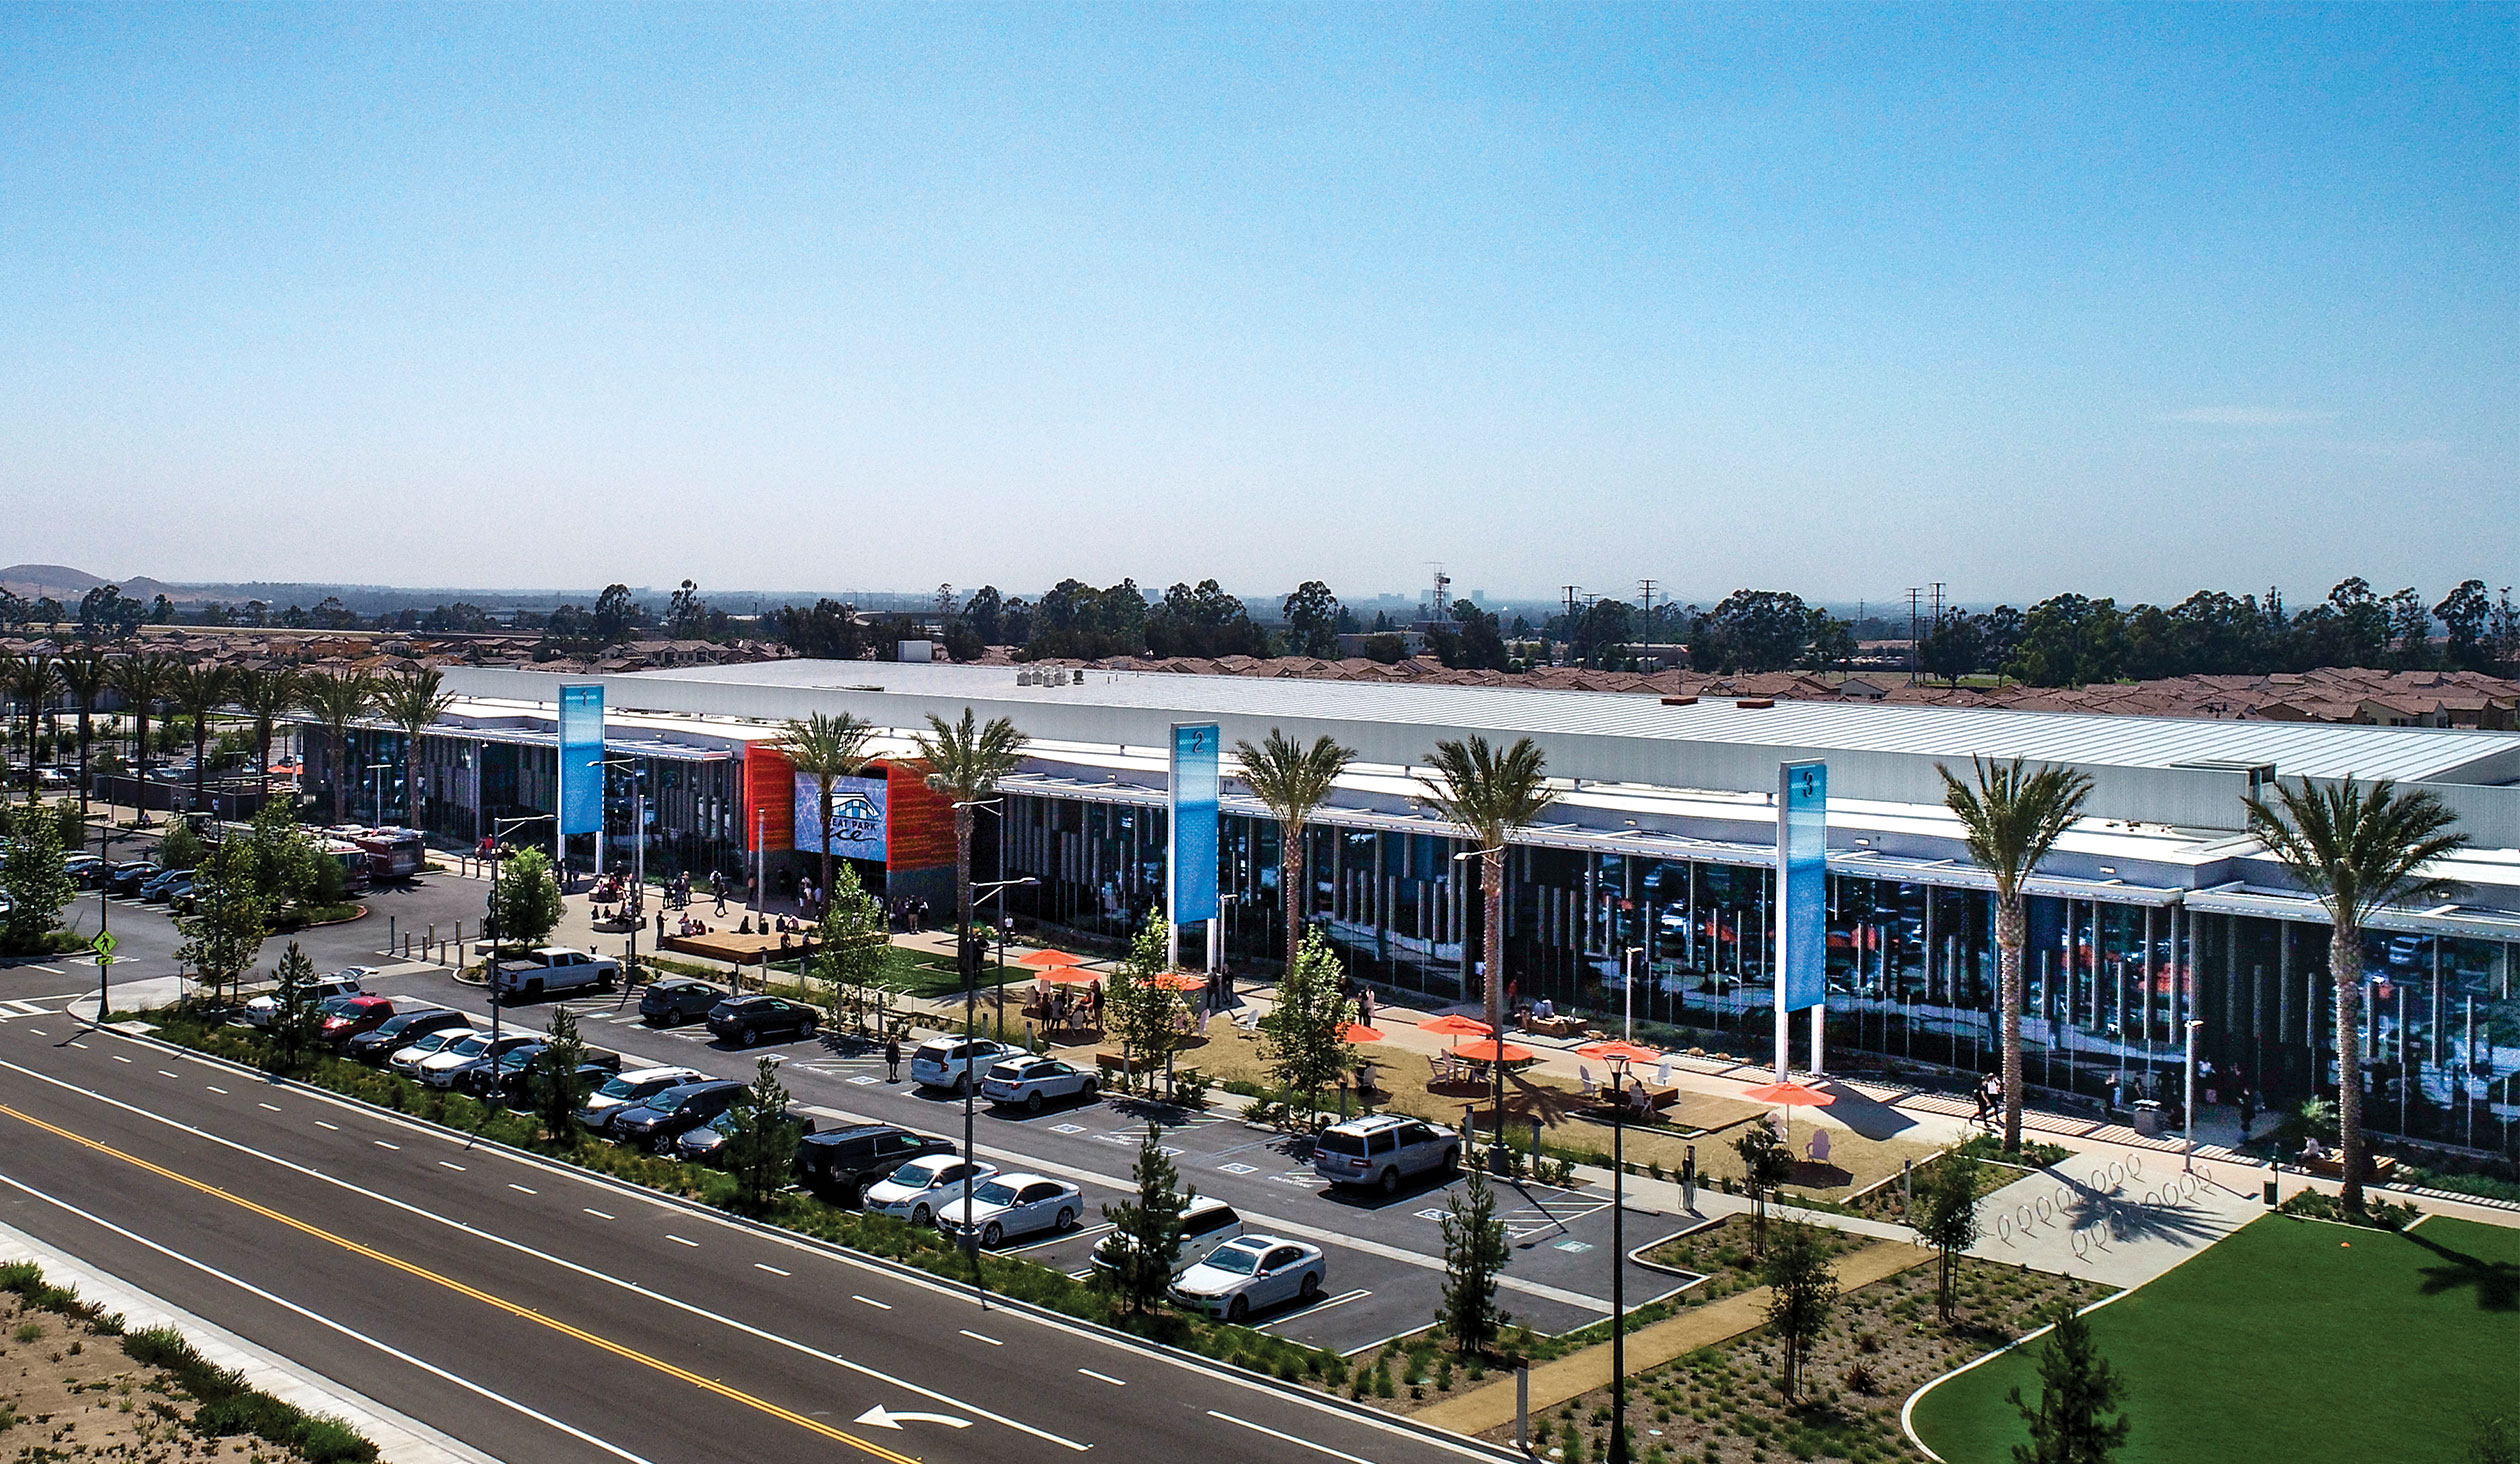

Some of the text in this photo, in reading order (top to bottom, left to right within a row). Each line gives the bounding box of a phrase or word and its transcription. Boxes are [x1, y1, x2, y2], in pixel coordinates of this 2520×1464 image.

[580, 689, 587, 706] 1
[1193, 731, 1204, 752] 2
[1803, 771, 1814, 798] 3
[851, 820, 876, 831] PARK
